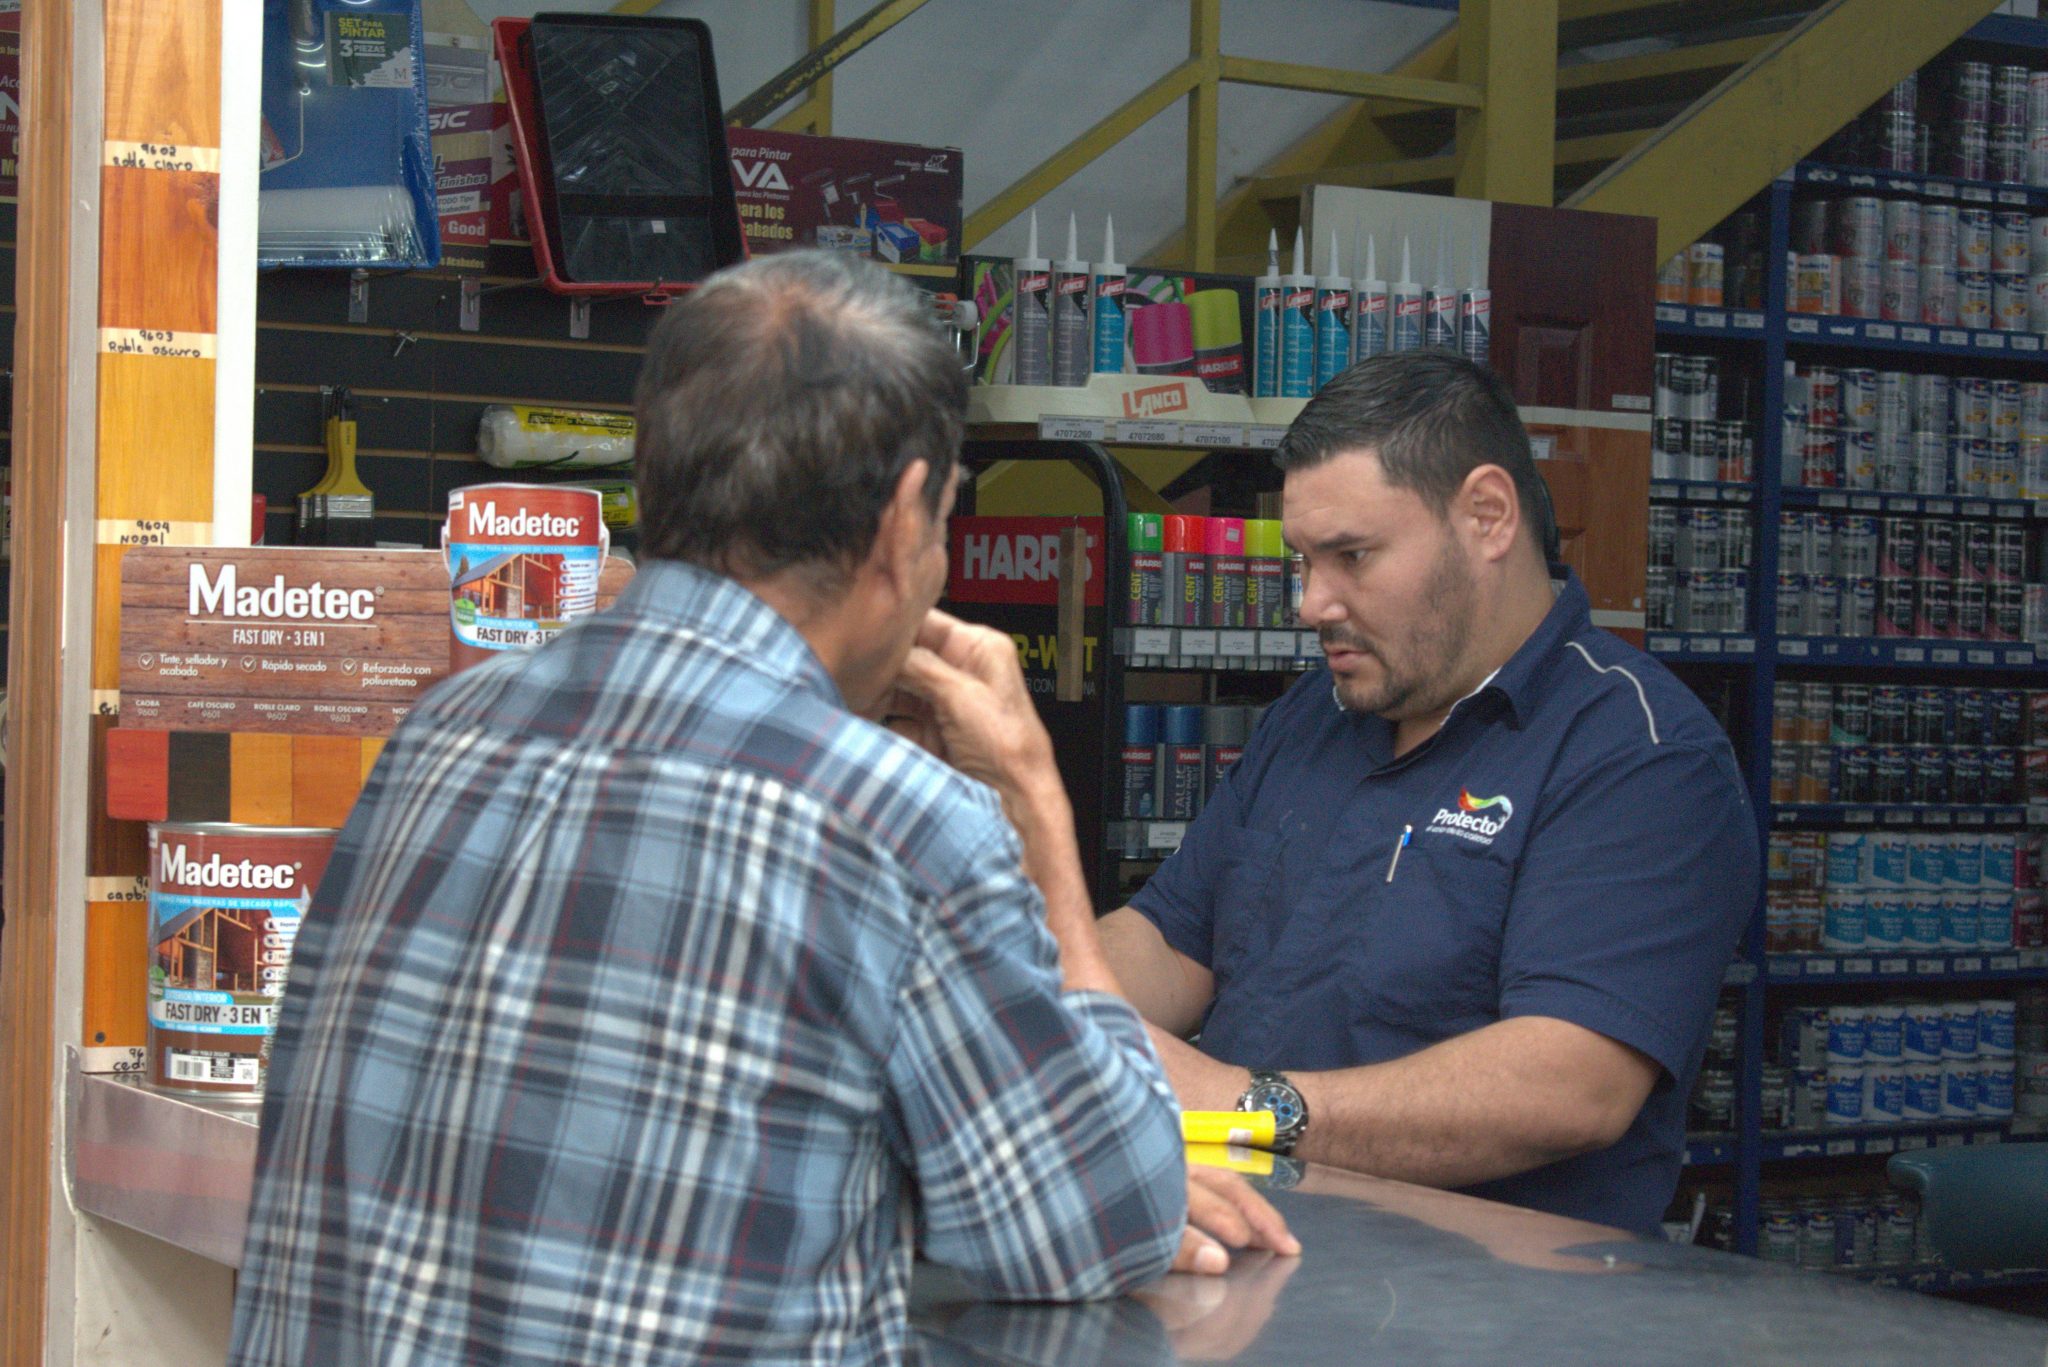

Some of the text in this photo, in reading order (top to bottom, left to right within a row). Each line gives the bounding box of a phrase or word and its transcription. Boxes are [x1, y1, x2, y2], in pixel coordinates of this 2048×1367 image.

[338, 18, 361, 28] SET
[340, 28, 385, 38] PINTAR
[340, 40, 386, 57] 3 PIEZAS
[759, 147, 791, 160] Pintar
[438, 173, 488, 189] Finishes
[738, 203, 785, 219] ara los
[448, 221, 486, 236] Good
[139, 329, 173, 342] 9603
[108, 337, 201, 358] Roble oscuro
[1127, 387, 1182, 417] LANCO
[136, 520, 170, 533] 9604
[469, 501, 580, 538] Madetec
[964, 534, 1094, 582] HARRS
[189, 563, 375, 620] Madetec
[233, 629, 325, 647] FAST DRY 3 EN 1
[477, 627, 503, 643] FAST
[505, 629, 529, 645] DRY
[535, 631, 543, 645] 3
[160, 653, 184, 666] Tinte,
[185, 654, 220, 666] sellador
[295, 662, 327, 672] secado
[160, 667, 198, 677] acabado
[362, 663, 432, 676] Reforzado con
[362, 676, 417, 688] poliuretano
[205, 702, 235, 710] OSCURO
[254, 703, 301, 712] ROBLE CLARO
[314, 705, 368, 714] ROBLE OSCURO
[1432, 808, 1497, 835] Protecto
[161, 843, 294, 889] Madetec
[166, 1003, 191, 1021] FAST
[195, 1006, 220, 1023] DRY
[230, 1007, 238, 1023] 3
[242, 1008, 261, 1024] EN
